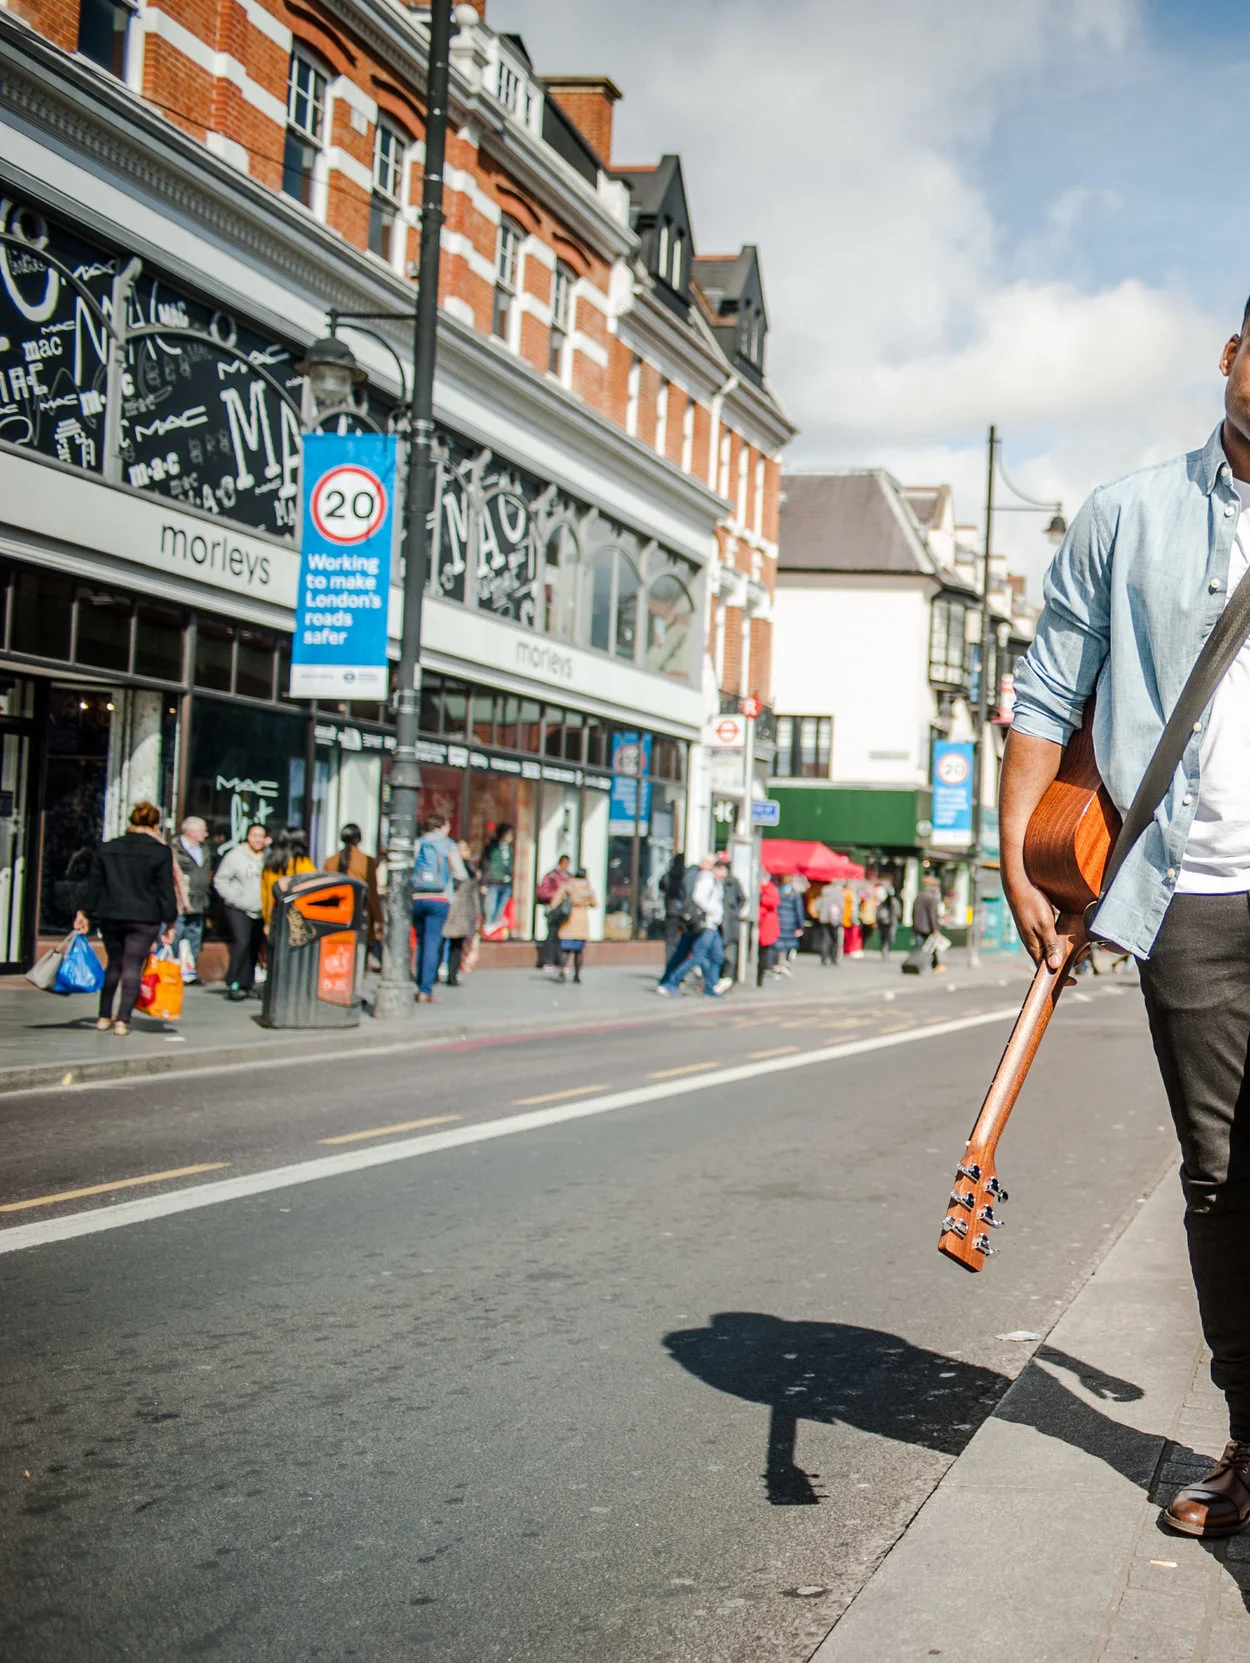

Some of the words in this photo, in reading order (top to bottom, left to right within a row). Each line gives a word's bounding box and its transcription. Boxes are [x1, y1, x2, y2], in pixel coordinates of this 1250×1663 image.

[22, 336, 62, 361] mac
[135, 405, 208, 442] MAC
[325, 490, 375, 519] 20
[160, 523, 270, 585] morleys
[307, 553, 380, 575] Working
[305, 573, 327, 589] to
[329, 573, 377, 590] make
[305, 590, 382, 609] London's
[304, 610, 353, 627] roads
[303, 628, 348, 645] safer
[516, 640, 573, 680] morleys
[216, 775, 280, 797] MAC
